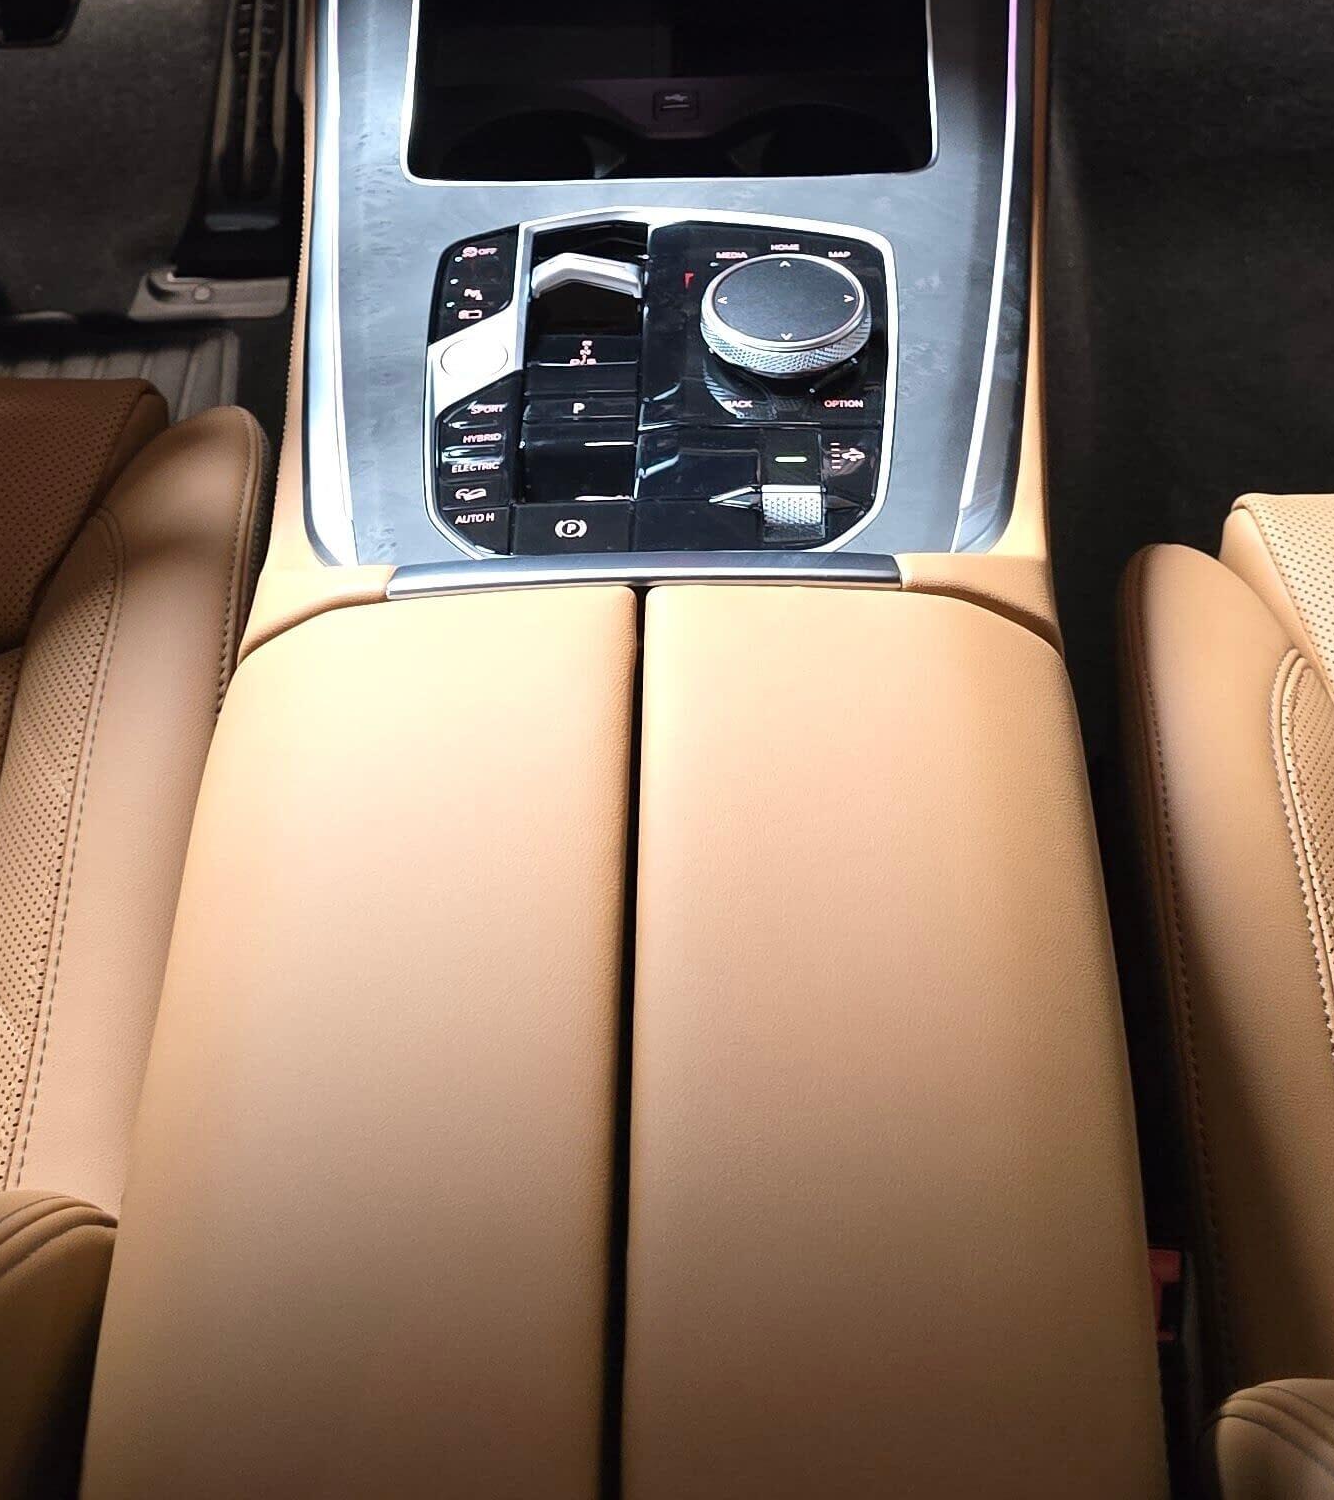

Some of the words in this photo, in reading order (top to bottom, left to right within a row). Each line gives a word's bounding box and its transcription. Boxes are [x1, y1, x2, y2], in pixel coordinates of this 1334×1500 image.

[470, 404, 504, 414] SPORT
[573, 402, 585, 414] P
[824, 400, 863, 408] OPTION
[462, 433, 502, 444] HYBRID
[451, 462, 500, 473] ELECTRIC
[455, 513, 485, 525] AUTO
[485, 512, 495, 522] H
